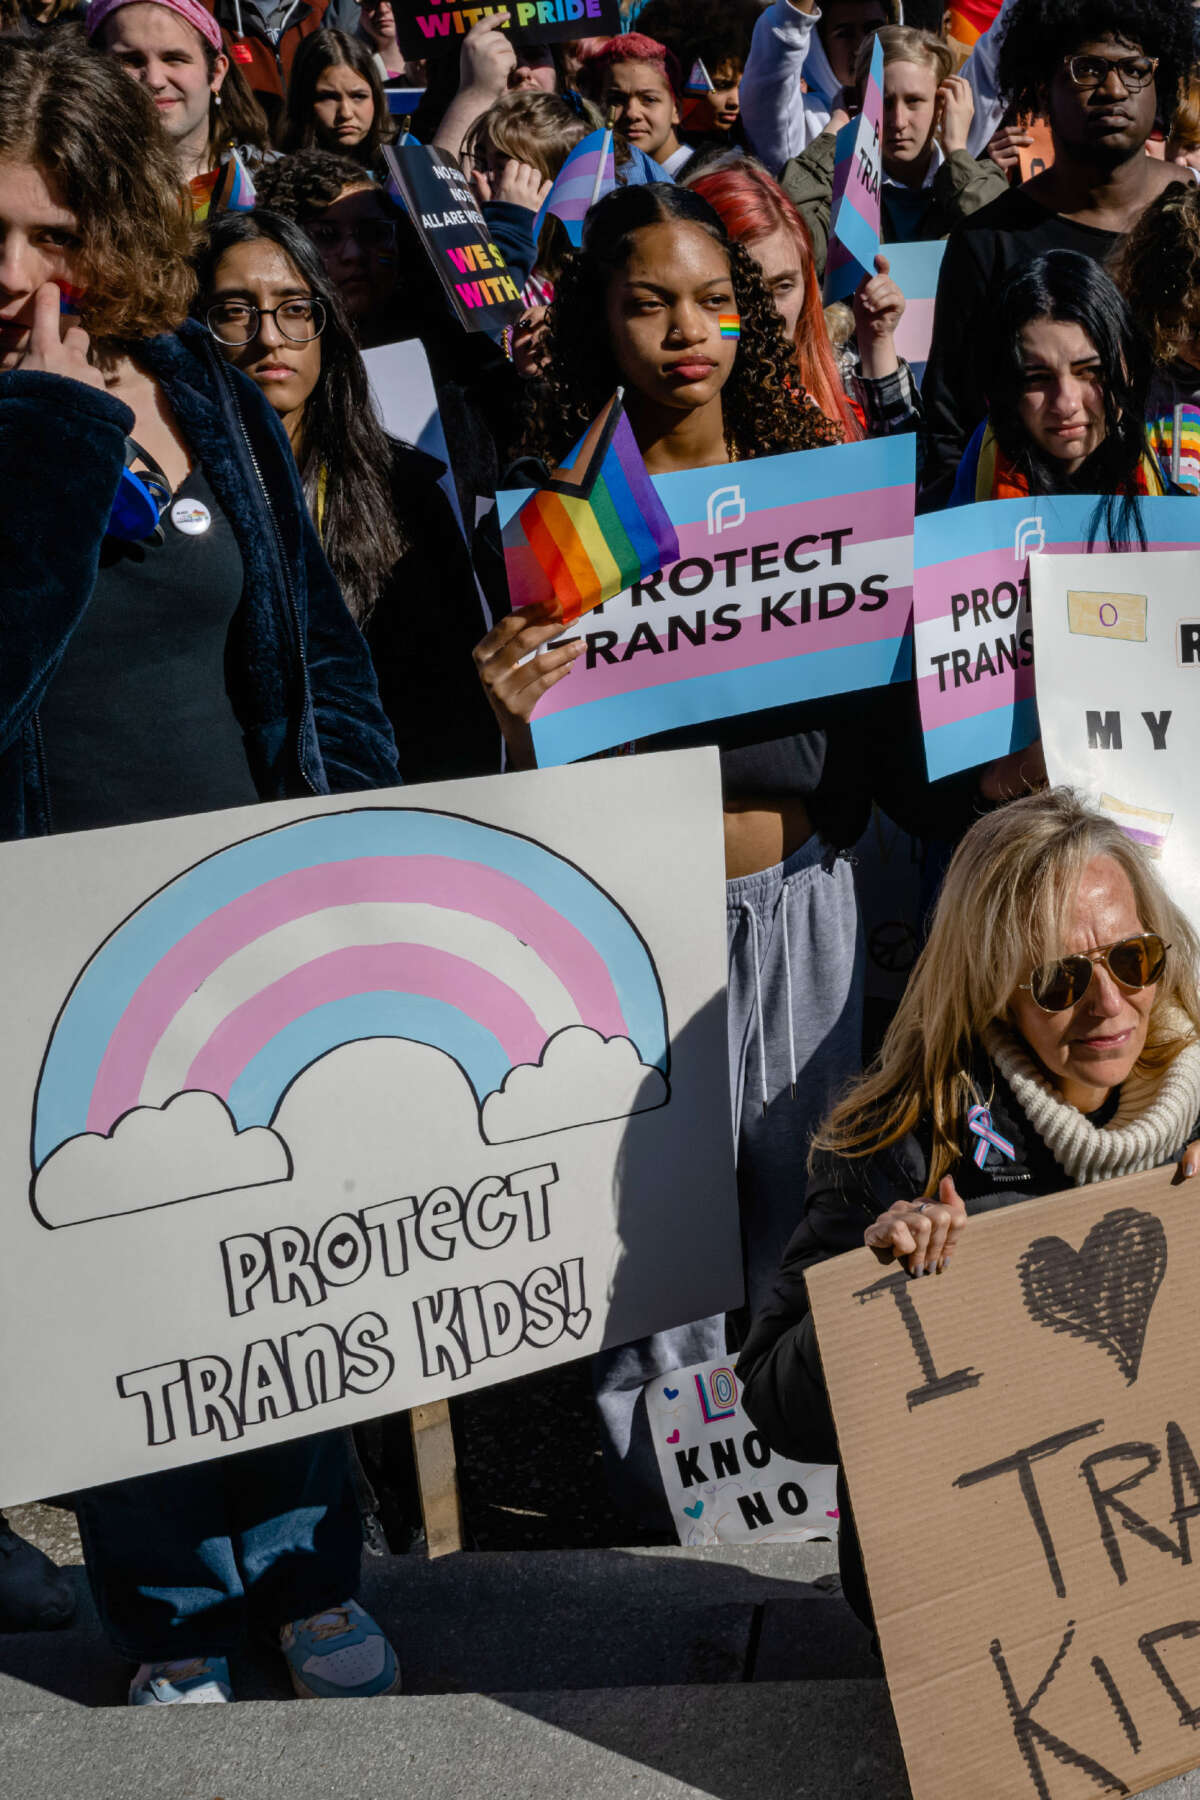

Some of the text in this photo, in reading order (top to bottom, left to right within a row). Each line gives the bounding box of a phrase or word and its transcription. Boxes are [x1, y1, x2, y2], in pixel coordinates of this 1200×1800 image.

[517, 0, 602, 27] PRIDE
[432, 166, 451, 180] NO
[450, 188, 467, 202] NO
[857, 147, 880, 206] TRA
[421, 213, 444, 229] ALL
[443, 210, 468, 226] ARE
[446, 245, 493, 274] WE
[456, 275, 521, 309] WITH
[593, 528, 853, 614] ROTECT
[761, 574, 889, 632] KIDS
[931, 629, 1034, 692] TRANS
[1086, 710, 1172, 751] MY
[412, 1257, 592, 1381] KIDS!
[852, 1273, 984, 1413] I
[694, 1367, 738, 1425] LO
[675, 1430, 771, 1488] KNO
[737, 1482, 808, 1530] NO
